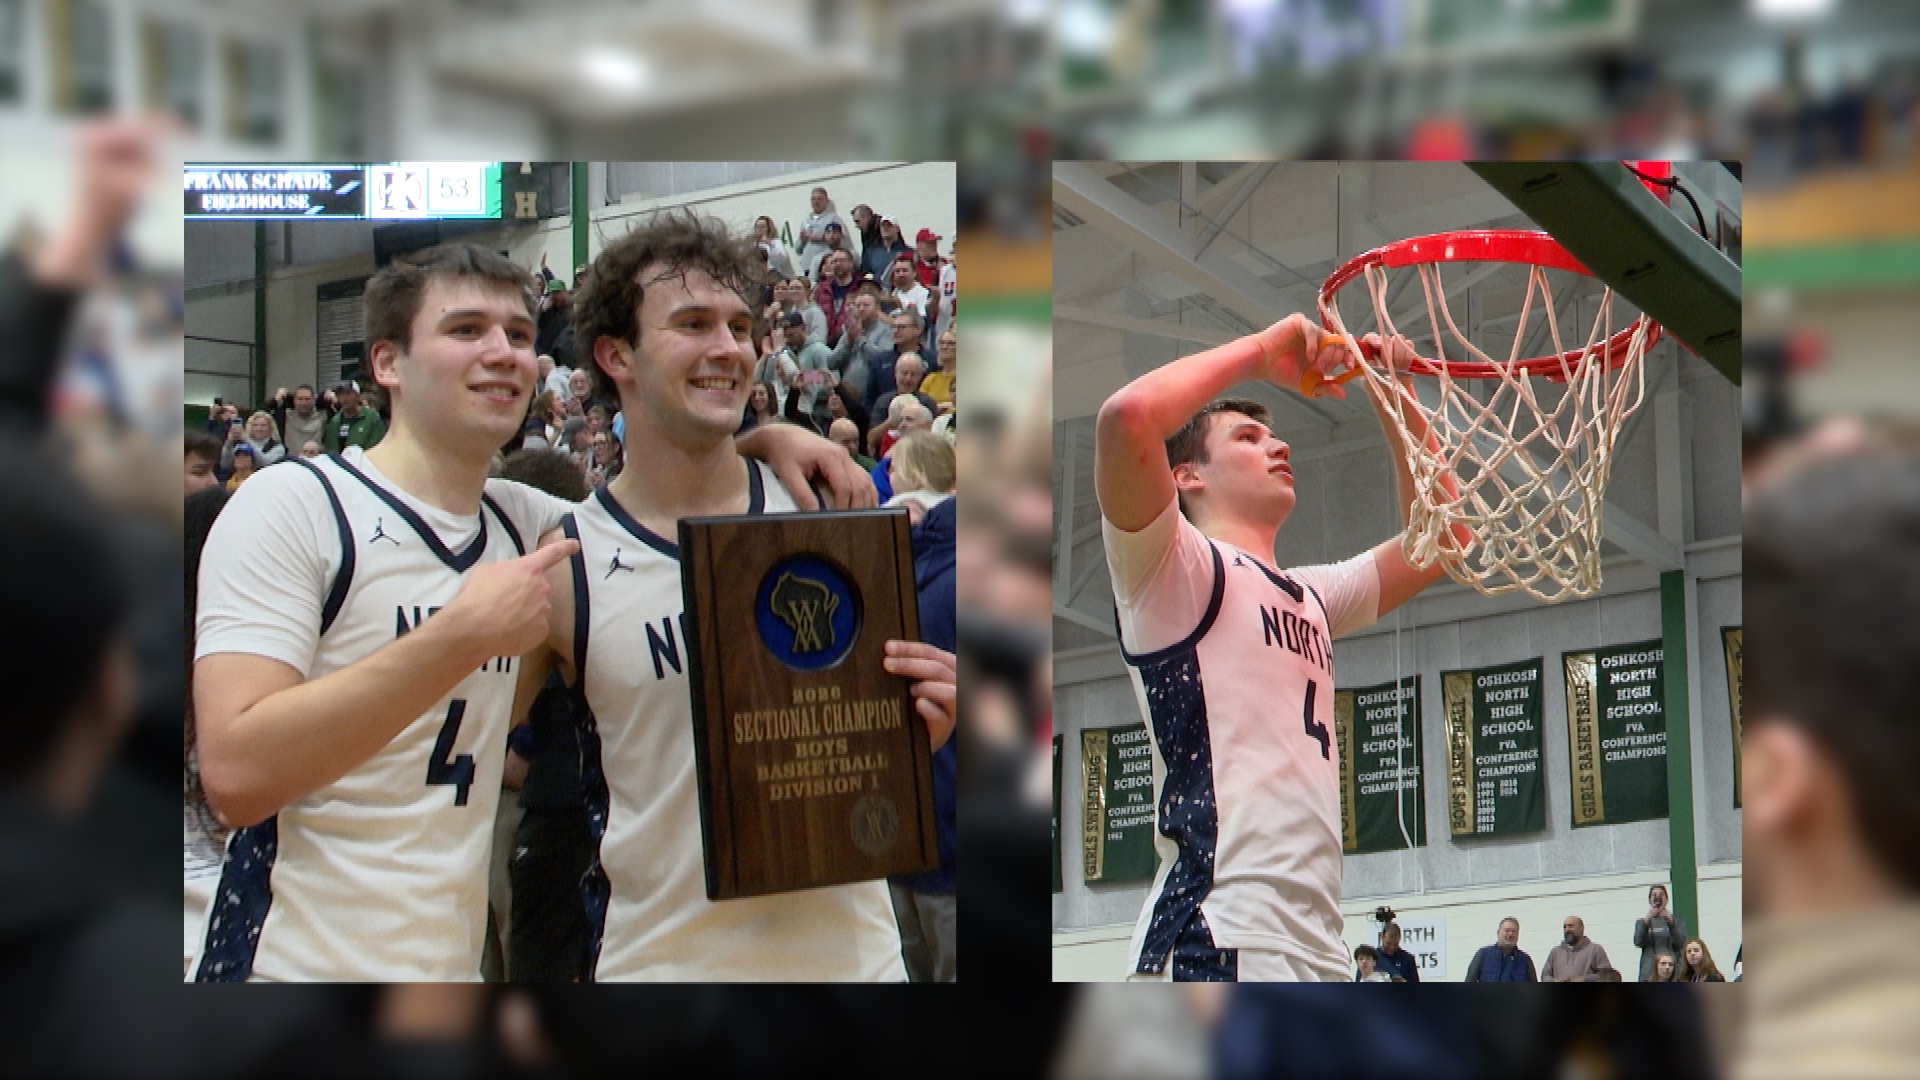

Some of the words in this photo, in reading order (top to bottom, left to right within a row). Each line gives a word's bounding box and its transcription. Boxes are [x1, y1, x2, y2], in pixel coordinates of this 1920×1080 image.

[184, 171, 249, 190] FRANK
[251, 171, 332, 190] SCHADE
[440, 177, 469, 199] 53
[202, 193, 310, 210] FIELDHOUSE
[1260, 604, 1334, 680] NORTH
[1600, 650, 1664, 669] OSHKOSH
[1477, 669, 1538, 688] OSHKOSH
[1610, 667, 1658, 685] NORTH
[1357, 687, 1415, 706] OSHKOSH
[1485, 686, 1530, 703] NORTH
[1616, 686, 1652, 701] HIGH
[1303, 677, 1331, 761] 4
[1366, 704, 1408, 721] NORTH
[1491, 703, 1524, 719] HIGH
[1606, 702, 1662, 719] SCHOOL
[733, 705, 821, 745] SECTIONAL
[823, 697, 901, 735] CHAMPION
[1481, 719, 1534, 737] SCHOOL
[1575, 680, 1594, 771] BASKETBALL
[1626, 722, 1645, 733] FVA
[426, 699, 476, 806] 4
[795, 737, 848, 759] BOYS
[1362, 737, 1413, 753] SCHOOL
[1499, 740, 1518, 751] FVA
[1605, 746, 1667, 762] CHAMPIONS
[1379, 756, 1397, 767] FVA
[1476, 748, 1539, 765] CONFERENCE
[757, 753, 889, 782] BASKETBALL
[1122, 760, 1151, 774] HIGH
[1479, 762, 1537, 777] CHAMPIONS
[770, 774, 863, 801] DIVISION
[1128, 793, 1144, 803] FVA
[1580, 775, 1596, 819] GIRLS
